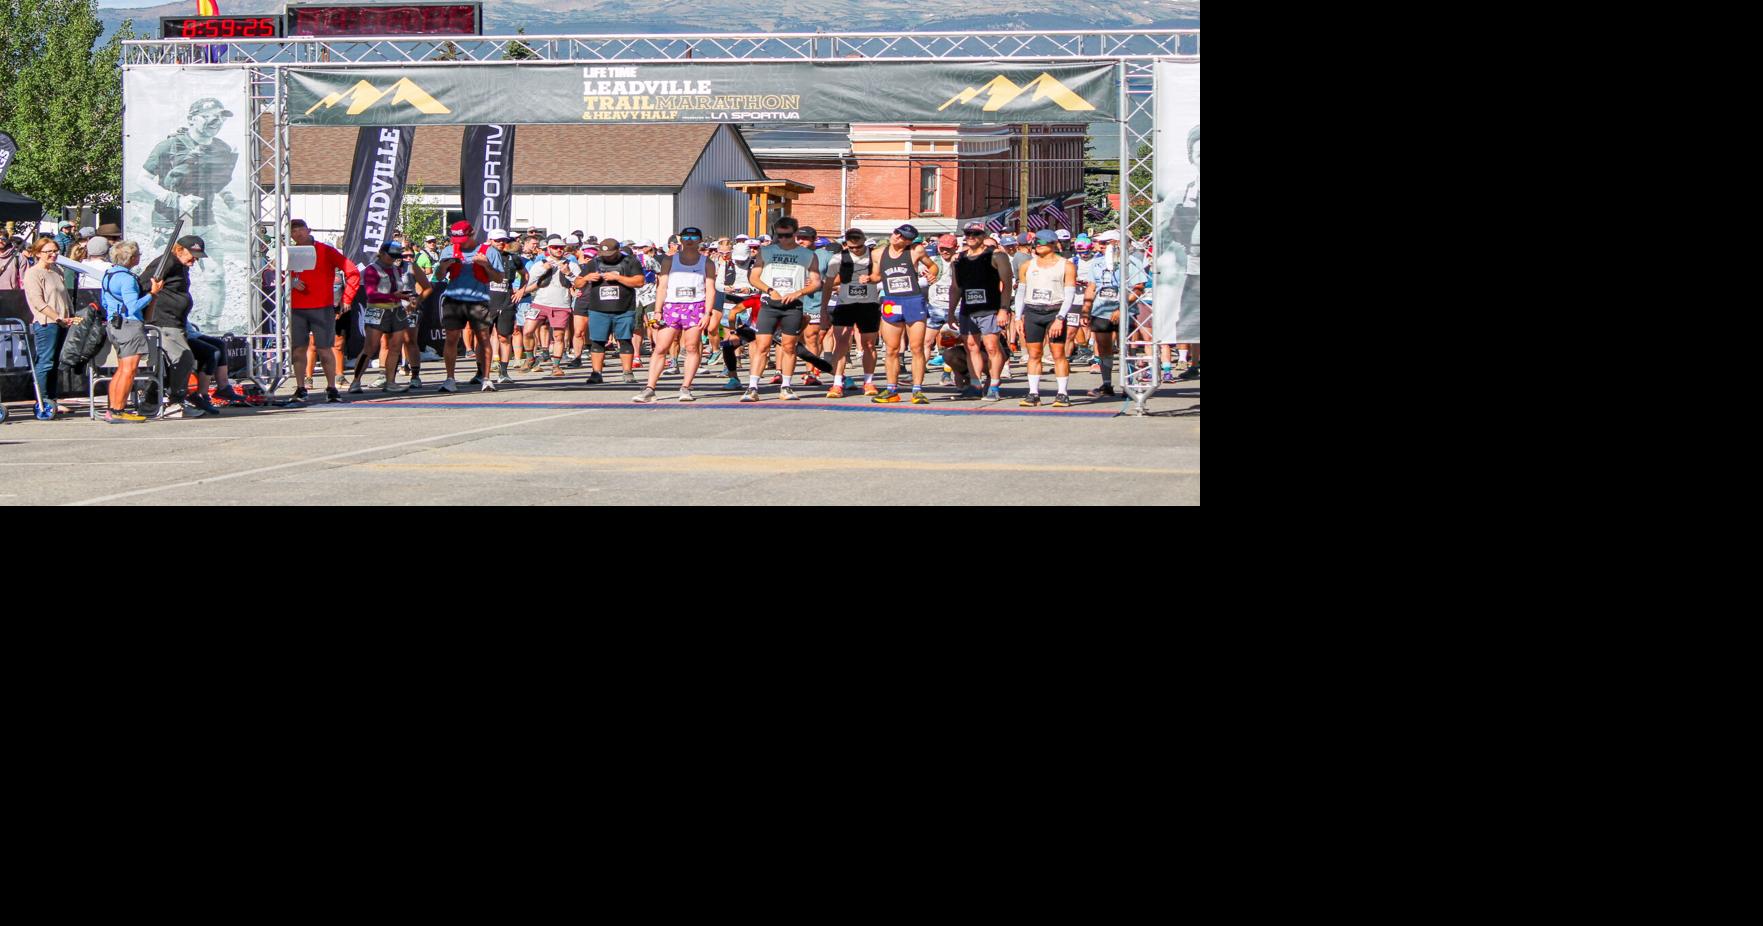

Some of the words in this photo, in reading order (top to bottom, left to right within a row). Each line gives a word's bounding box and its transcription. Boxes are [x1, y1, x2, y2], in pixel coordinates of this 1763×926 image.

[583, 67, 608, 78] LIFE
[608, 67, 639, 78] TIME
[583, 80, 712, 95] LEADVILLE
[584, 95, 656, 111] TRAIL
[656, 95, 800, 110] MARATHON
[582, 111, 593, 120] &
[593, 111, 641, 120] HEAVY
[643, 111, 678, 120] HALF
[731, 111, 800, 119] SPORTIVA
[483, 124, 503, 233] SPORTIV
[363, 128, 400, 253] LEADVILLE
